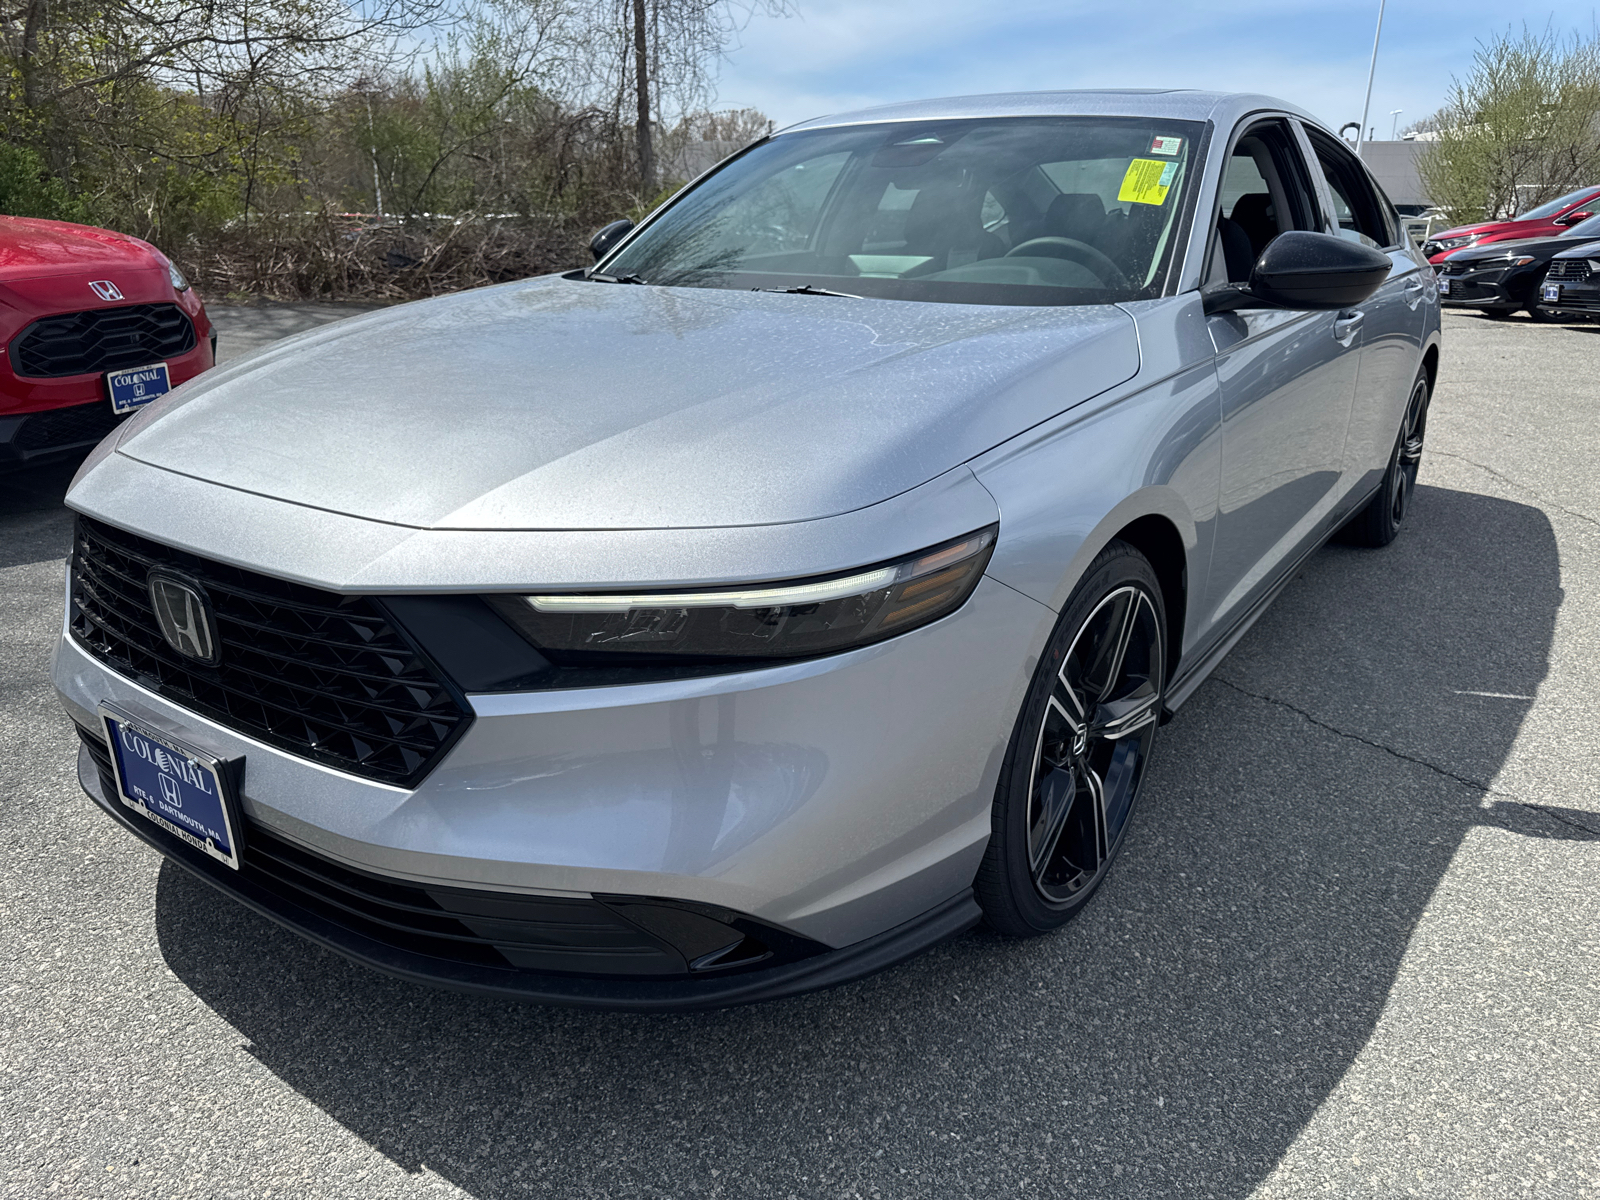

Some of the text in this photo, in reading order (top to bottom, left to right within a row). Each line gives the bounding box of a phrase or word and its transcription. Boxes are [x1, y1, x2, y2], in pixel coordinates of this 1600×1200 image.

[115, 370, 160, 387] COLONIAL
[122, 731, 212, 795] COLONIAL
[133, 785, 149, 801] RTE.
[159, 800, 208, 836] DARTMOUTH,
[207, 828, 222, 842] MA
[147, 811, 209, 853] COLONIAL HONDA
